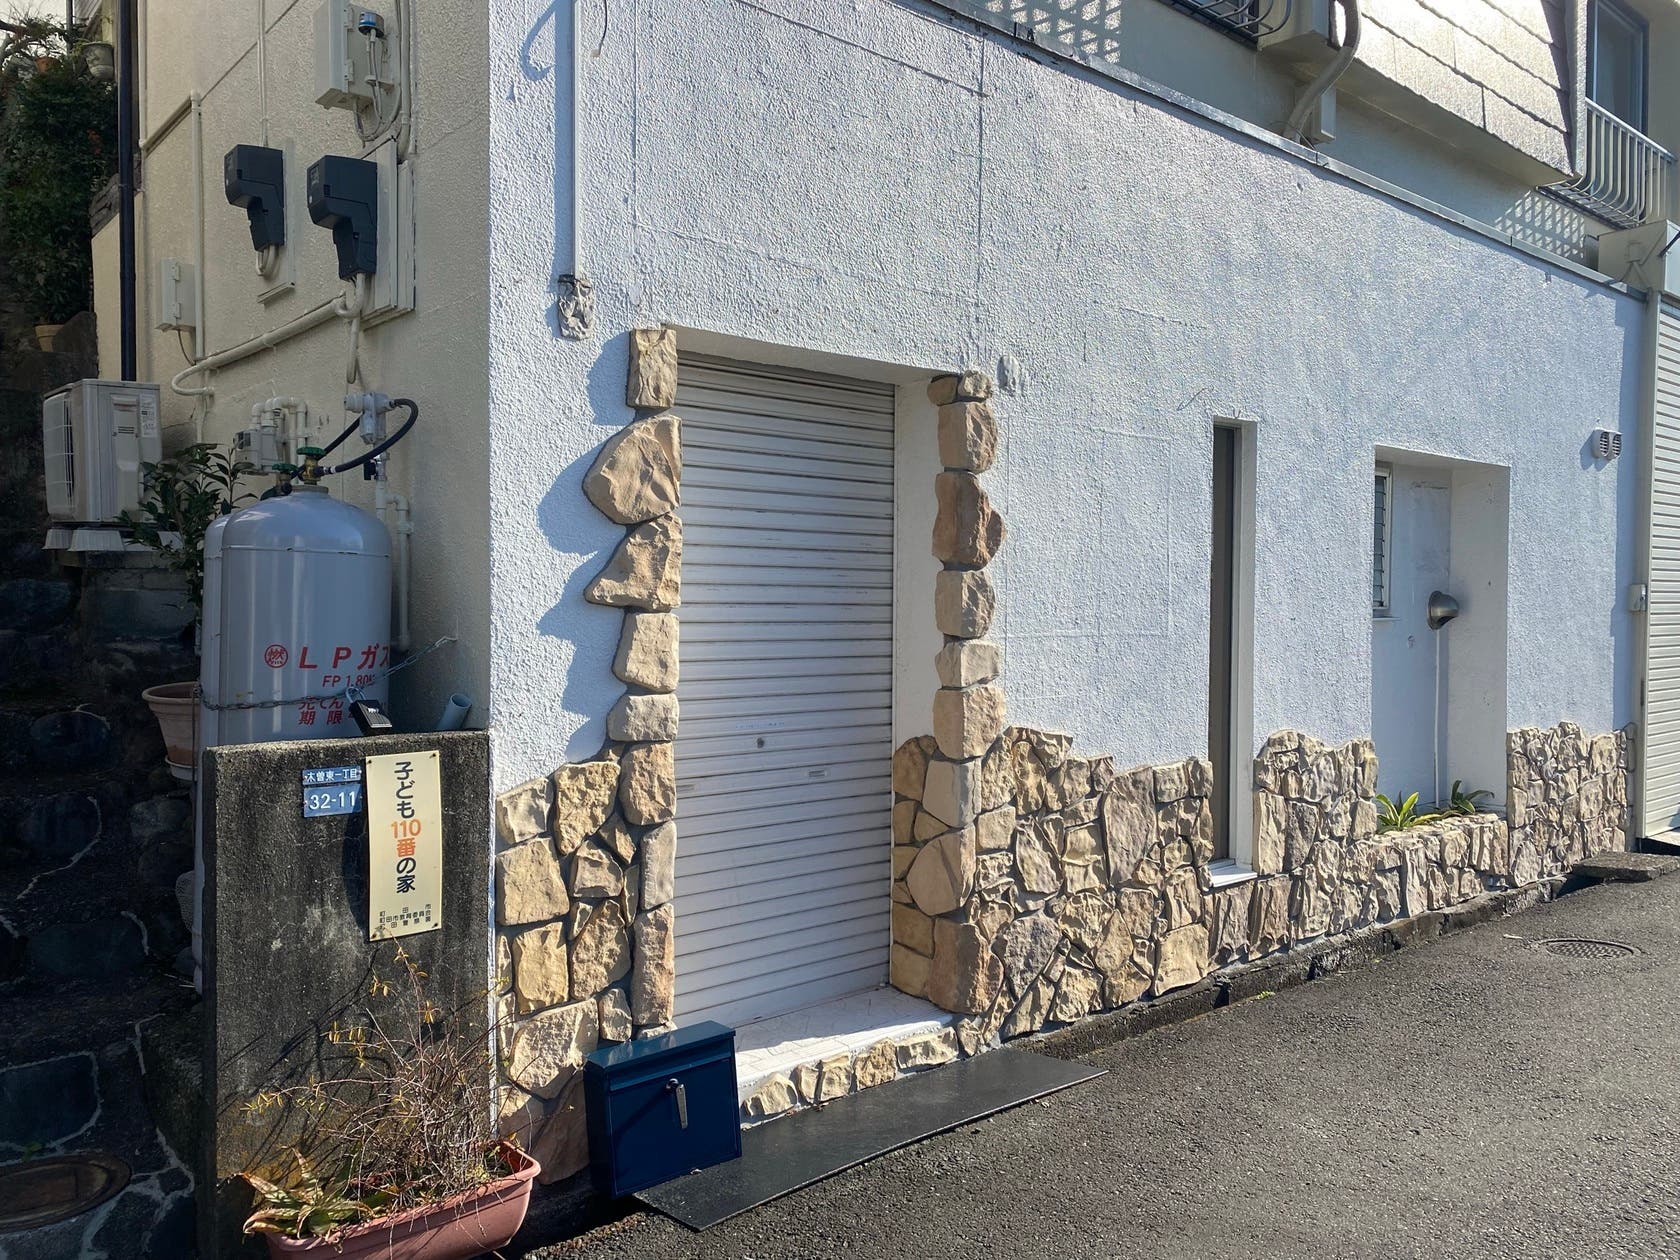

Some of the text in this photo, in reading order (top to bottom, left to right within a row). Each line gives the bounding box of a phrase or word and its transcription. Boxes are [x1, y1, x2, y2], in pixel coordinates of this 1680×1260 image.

[322, 675, 341, 687] FP
[307, 768, 357, 782] 木曽東一丁目
[309, 791, 355, 810] 32-11
[391, 761, 421, 893] 子ども110番の家
